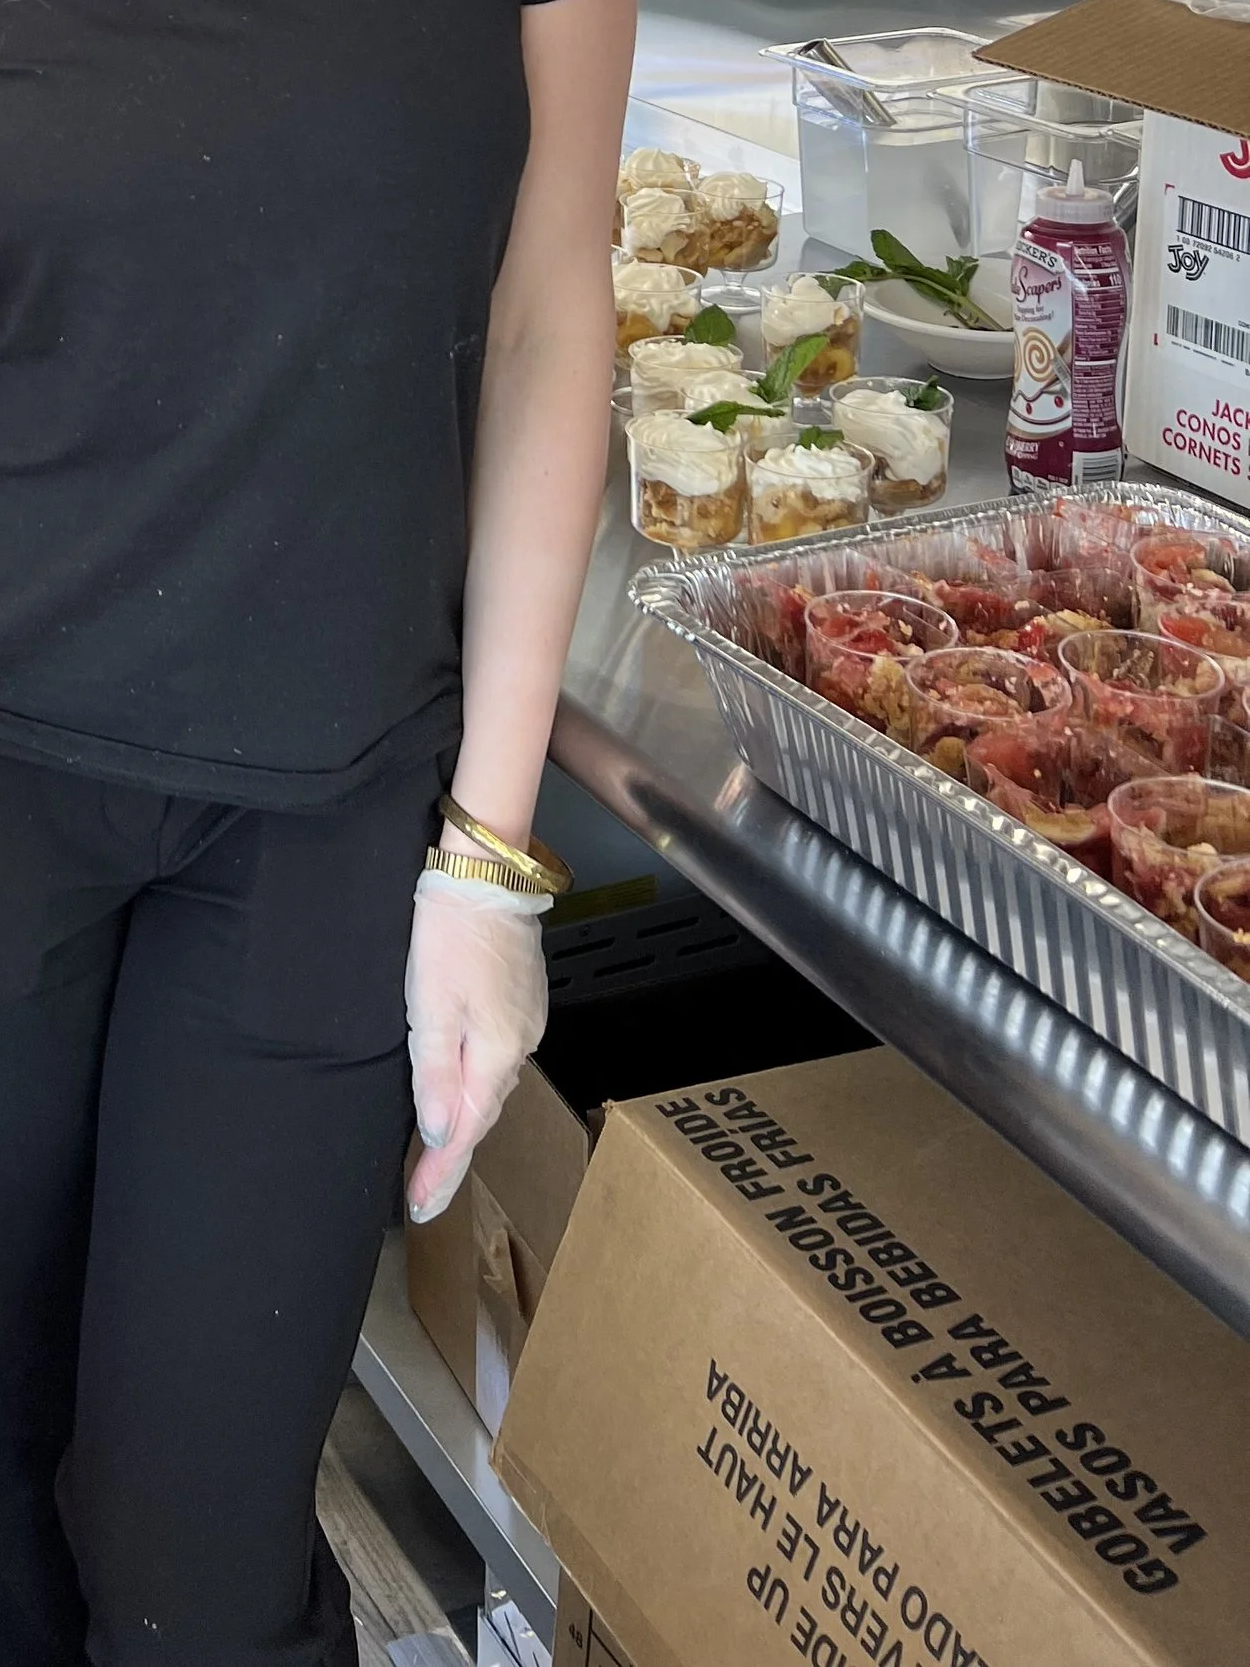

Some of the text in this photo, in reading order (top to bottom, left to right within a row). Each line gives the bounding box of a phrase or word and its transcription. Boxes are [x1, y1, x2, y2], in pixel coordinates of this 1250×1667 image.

[1167, 245, 1209, 281] Joy
[1162, 427, 1241, 476] CORNETS
[1176, 409, 1241, 451] CONOS
[655, 1097, 1179, 1595] GOBELETS À BOISSON FROIDE
[704, 1087, 1209, 1555] VASOS PARA BEBIDAS FRÍAS
[706, 1357, 814, 1498] ARRIBA
[697, 1425, 777, 1533] HAUT
[777, 1512, 821, 1582] LE
[816, 1481, 900, 1602] PARA
[747, 1564, 790, 1626] UP
